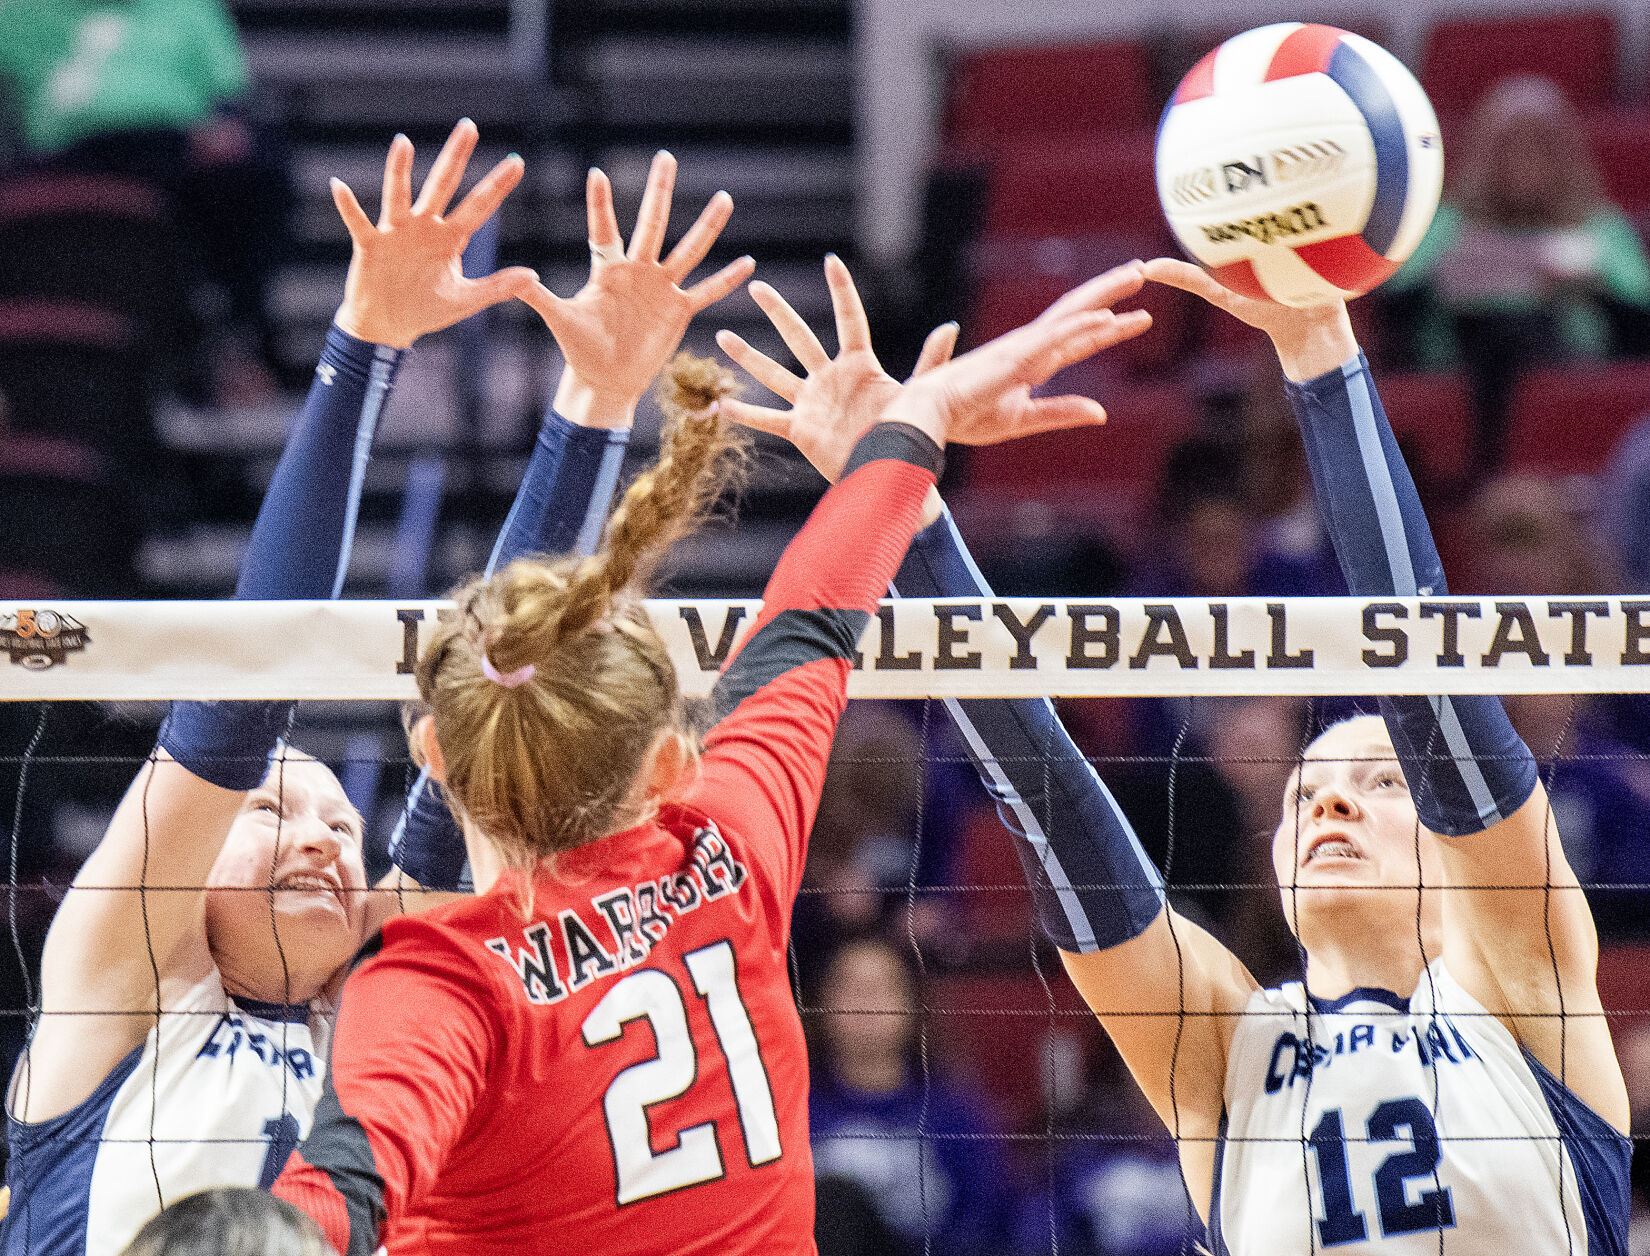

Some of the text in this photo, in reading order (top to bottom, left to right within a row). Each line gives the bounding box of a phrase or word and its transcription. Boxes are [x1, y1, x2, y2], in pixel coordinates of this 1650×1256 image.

[679, 602, 1650, 671] VLEYBALL STATE
[581, 936, 784, 1209] 21
[1305, 1096, 1458, 1249] 12
